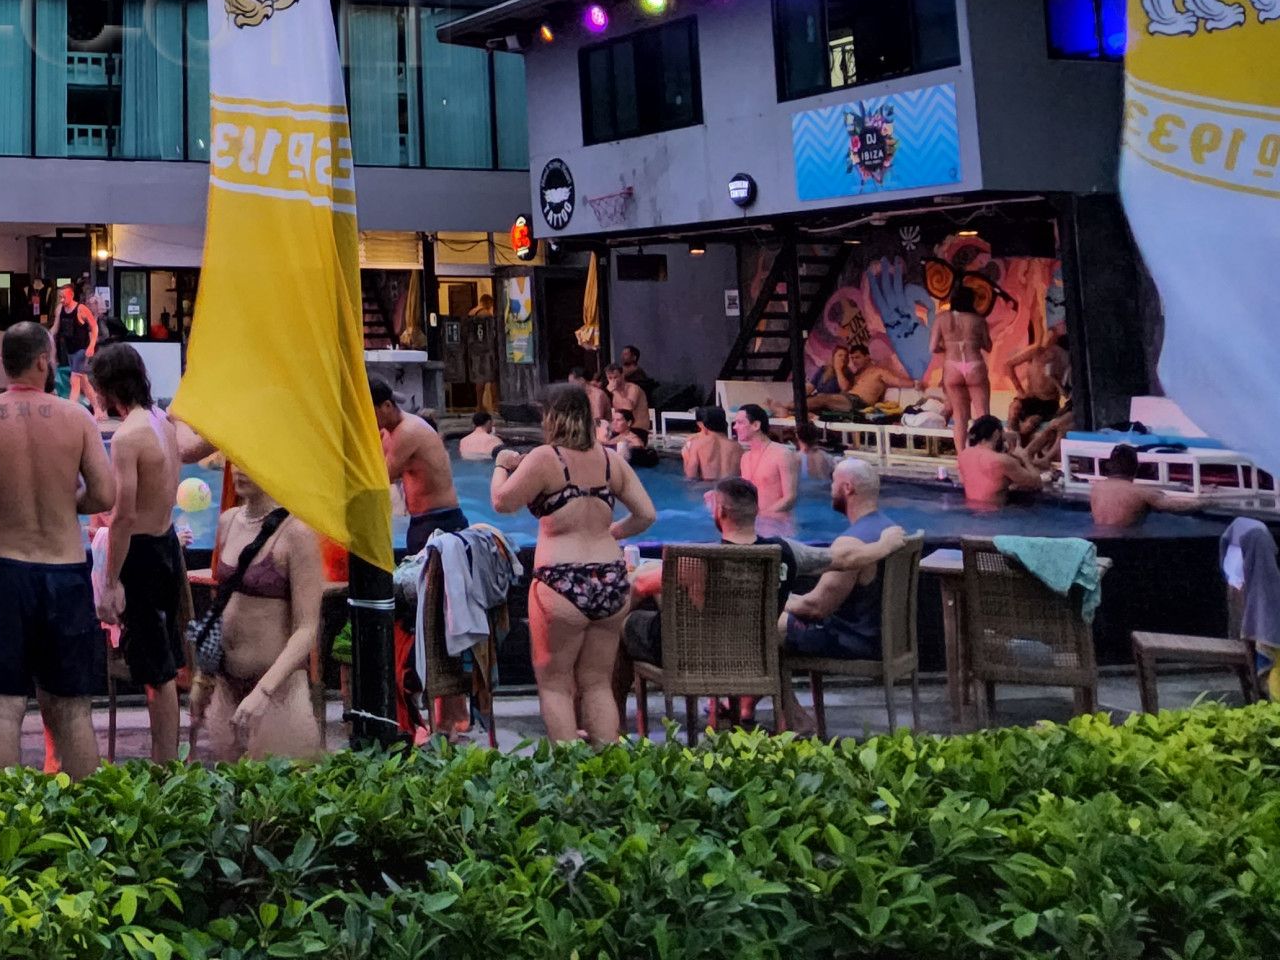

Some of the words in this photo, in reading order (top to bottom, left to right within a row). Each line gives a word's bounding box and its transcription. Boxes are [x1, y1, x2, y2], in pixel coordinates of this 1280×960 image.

[865, 133, 877, 145] DJ
[861, 149, 884, 160] IBIZA
[543, 201, 573, 227] TATTOO
